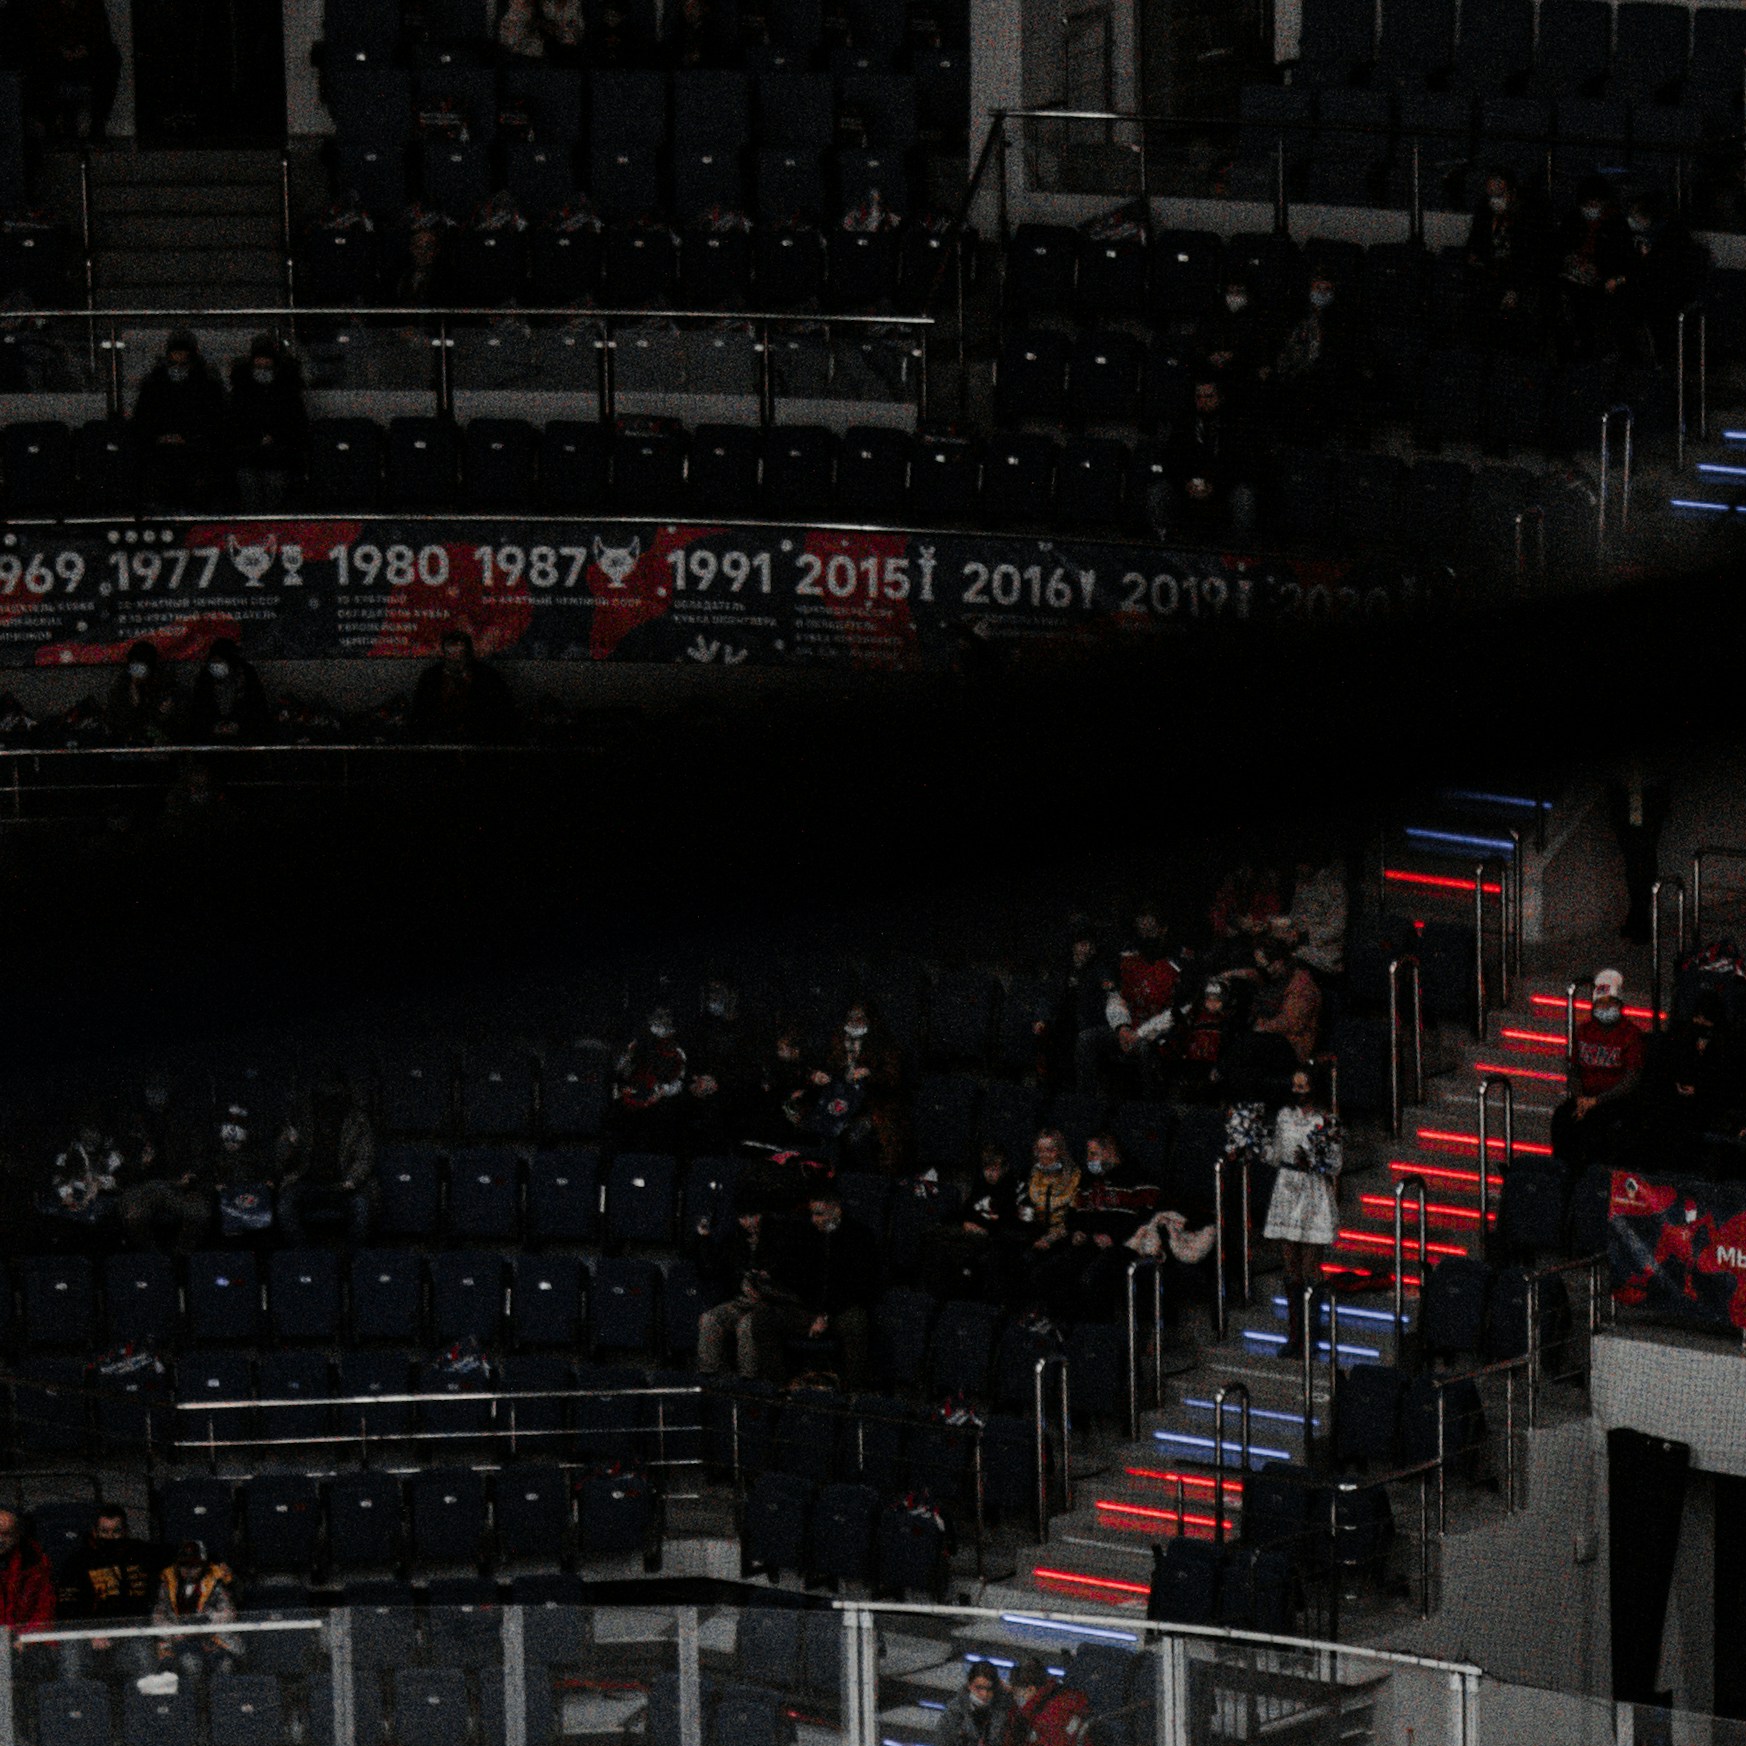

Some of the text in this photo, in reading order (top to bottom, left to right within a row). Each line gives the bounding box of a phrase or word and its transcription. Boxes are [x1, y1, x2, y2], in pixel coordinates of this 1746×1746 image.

[109, 548, 220, 591] 1977
[329, 544, 450, 587] 1980
[474, 545, 587, 588] 1987
[666, 549, 772, 593] 1991
[795, 554, 910, 599] 2015
[962, 562, 1073, 608] 2016
[1121, 572, 1229, 618] 2019
